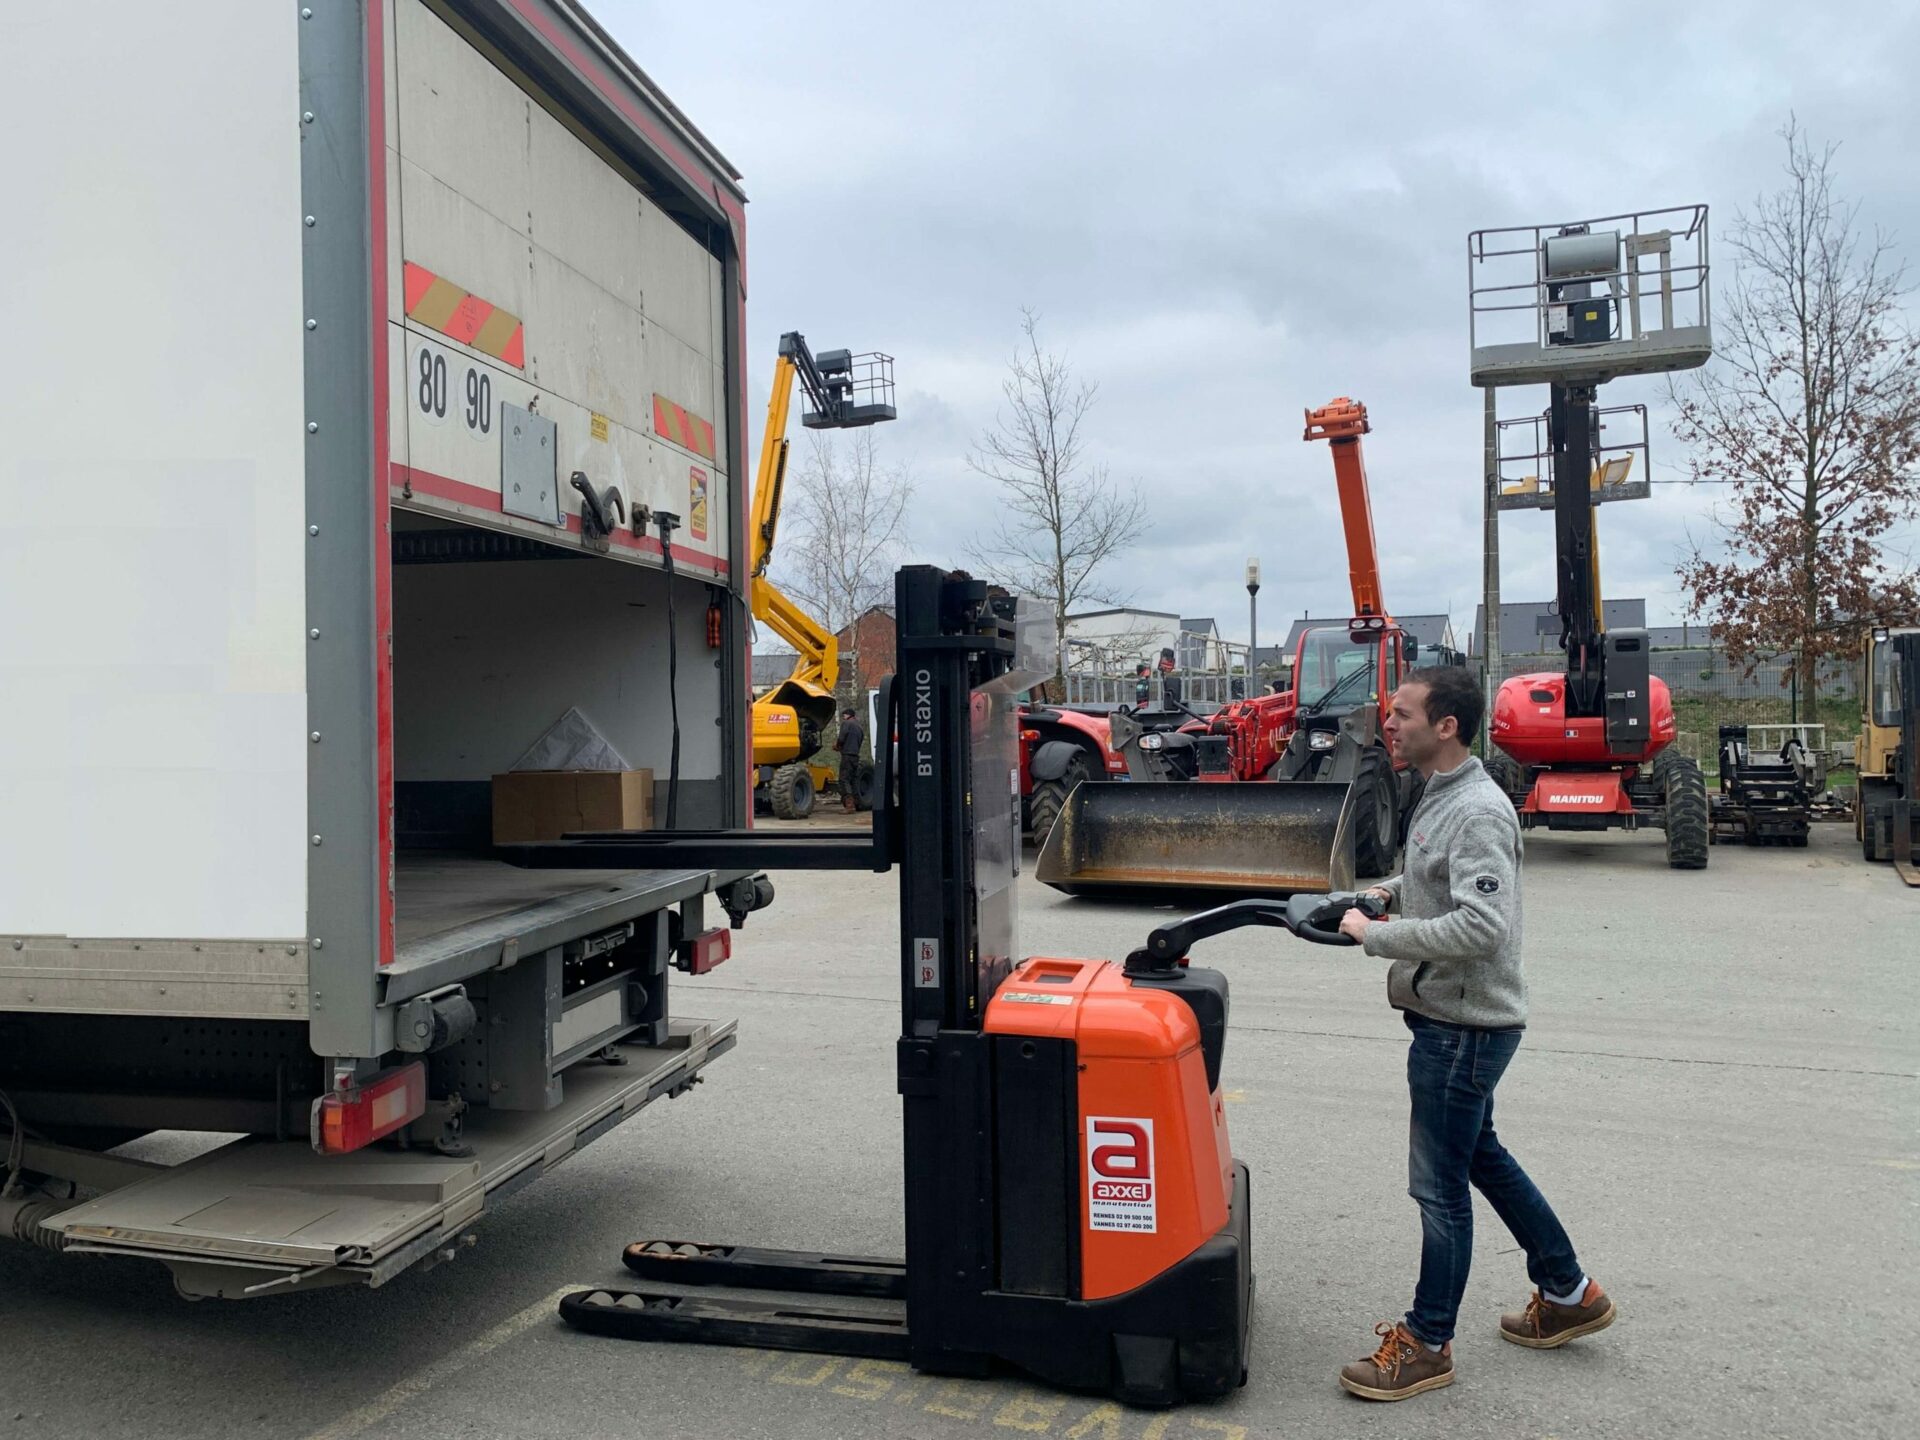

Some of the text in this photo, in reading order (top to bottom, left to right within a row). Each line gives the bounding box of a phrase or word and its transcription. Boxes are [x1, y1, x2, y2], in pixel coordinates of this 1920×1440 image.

[419, 348, 446, 418] 80
[466, 368, 491, 434] 90
[917, 751, 932, 776] BT
[1549, 794, 1604, 804] MANITOU
[1097, 1184, 1147, 1199] axxel
[1092, 1200, 1152, 1208] manutention
